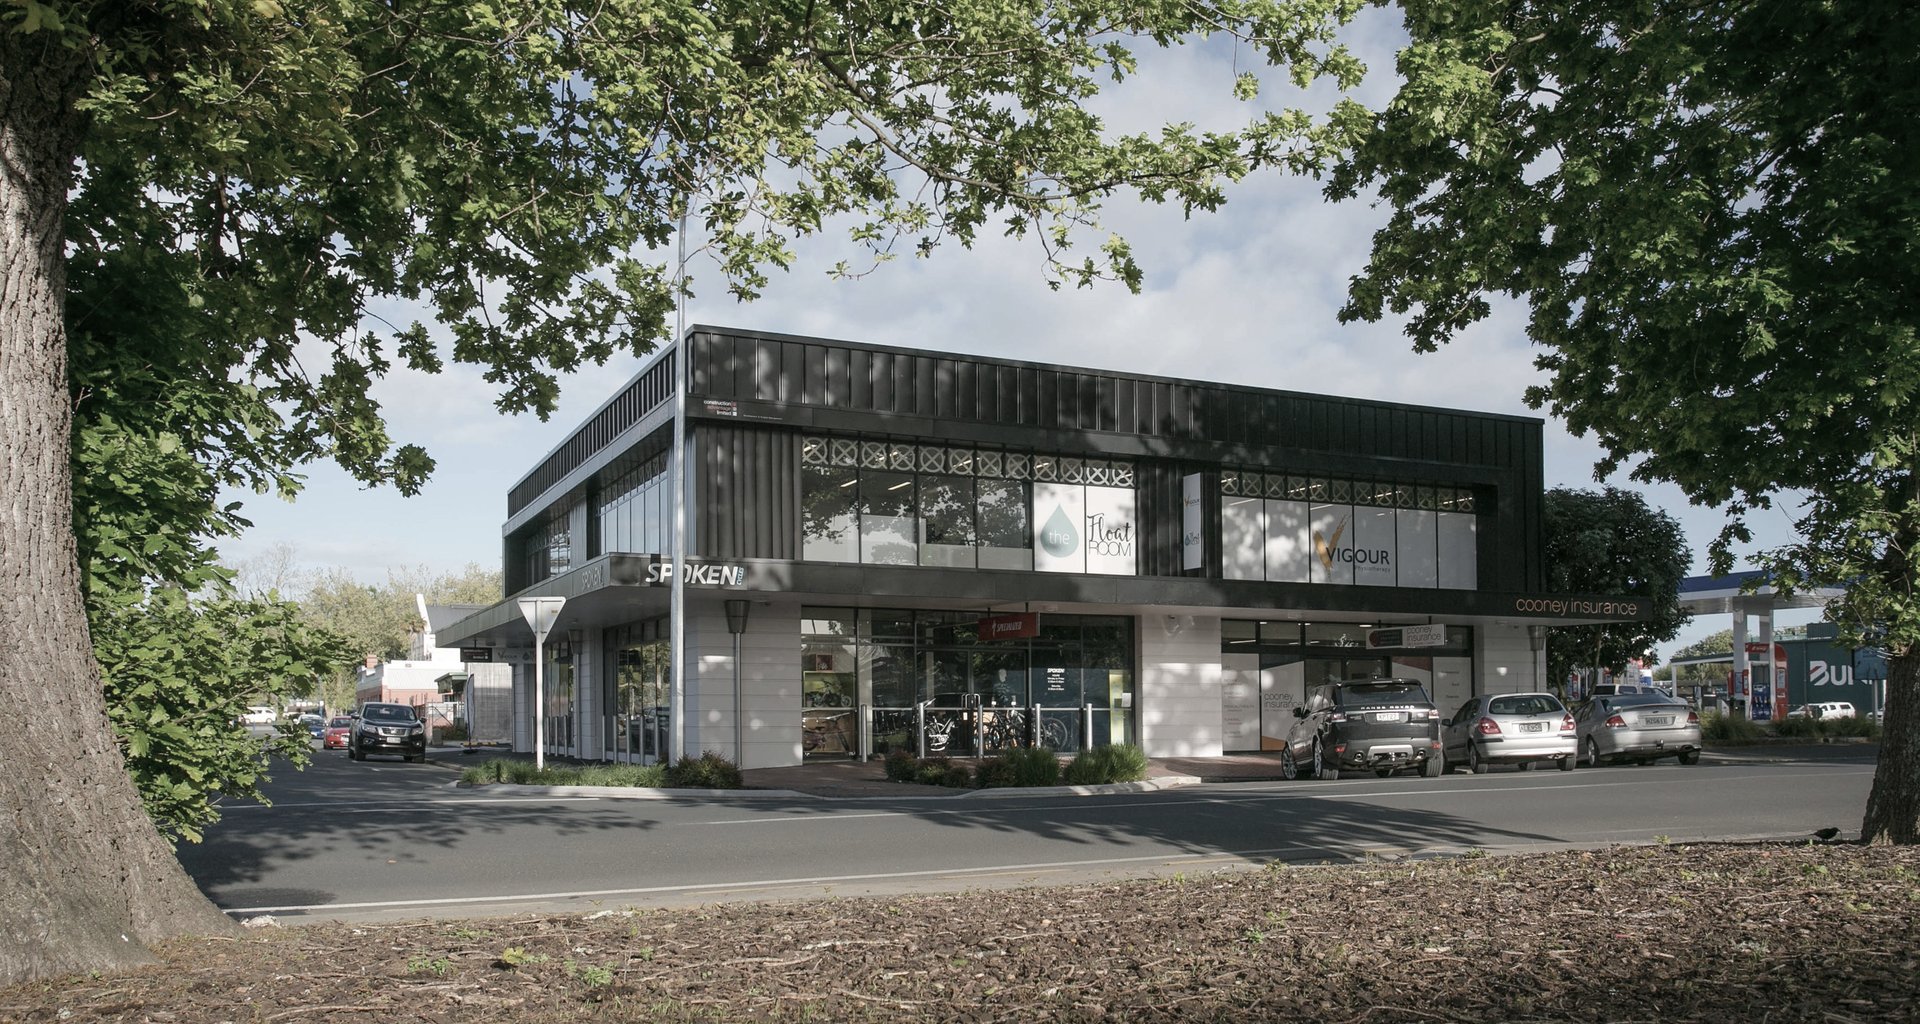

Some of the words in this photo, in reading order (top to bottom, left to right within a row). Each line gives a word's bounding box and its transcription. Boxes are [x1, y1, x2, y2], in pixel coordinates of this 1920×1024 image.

[1087, 512, 1134, 543] Float
[1049, 530, 1070, 545] the
[1088, 540, 1132, 557] ROOM
[1326, 547, 1390, 565] VIGOUR
[736, 566, 745, 586] CYCLES
[1516, 599, 1568, 616] cooney
[1570, 599, 1637, 615] insurance
[1407, 626, 1433, 634] cooney
[1407, 633, 1441, 641] insurance
[1264, 693, 1293, 703] cooney
[1264, 701, 1303, 709] insurance
